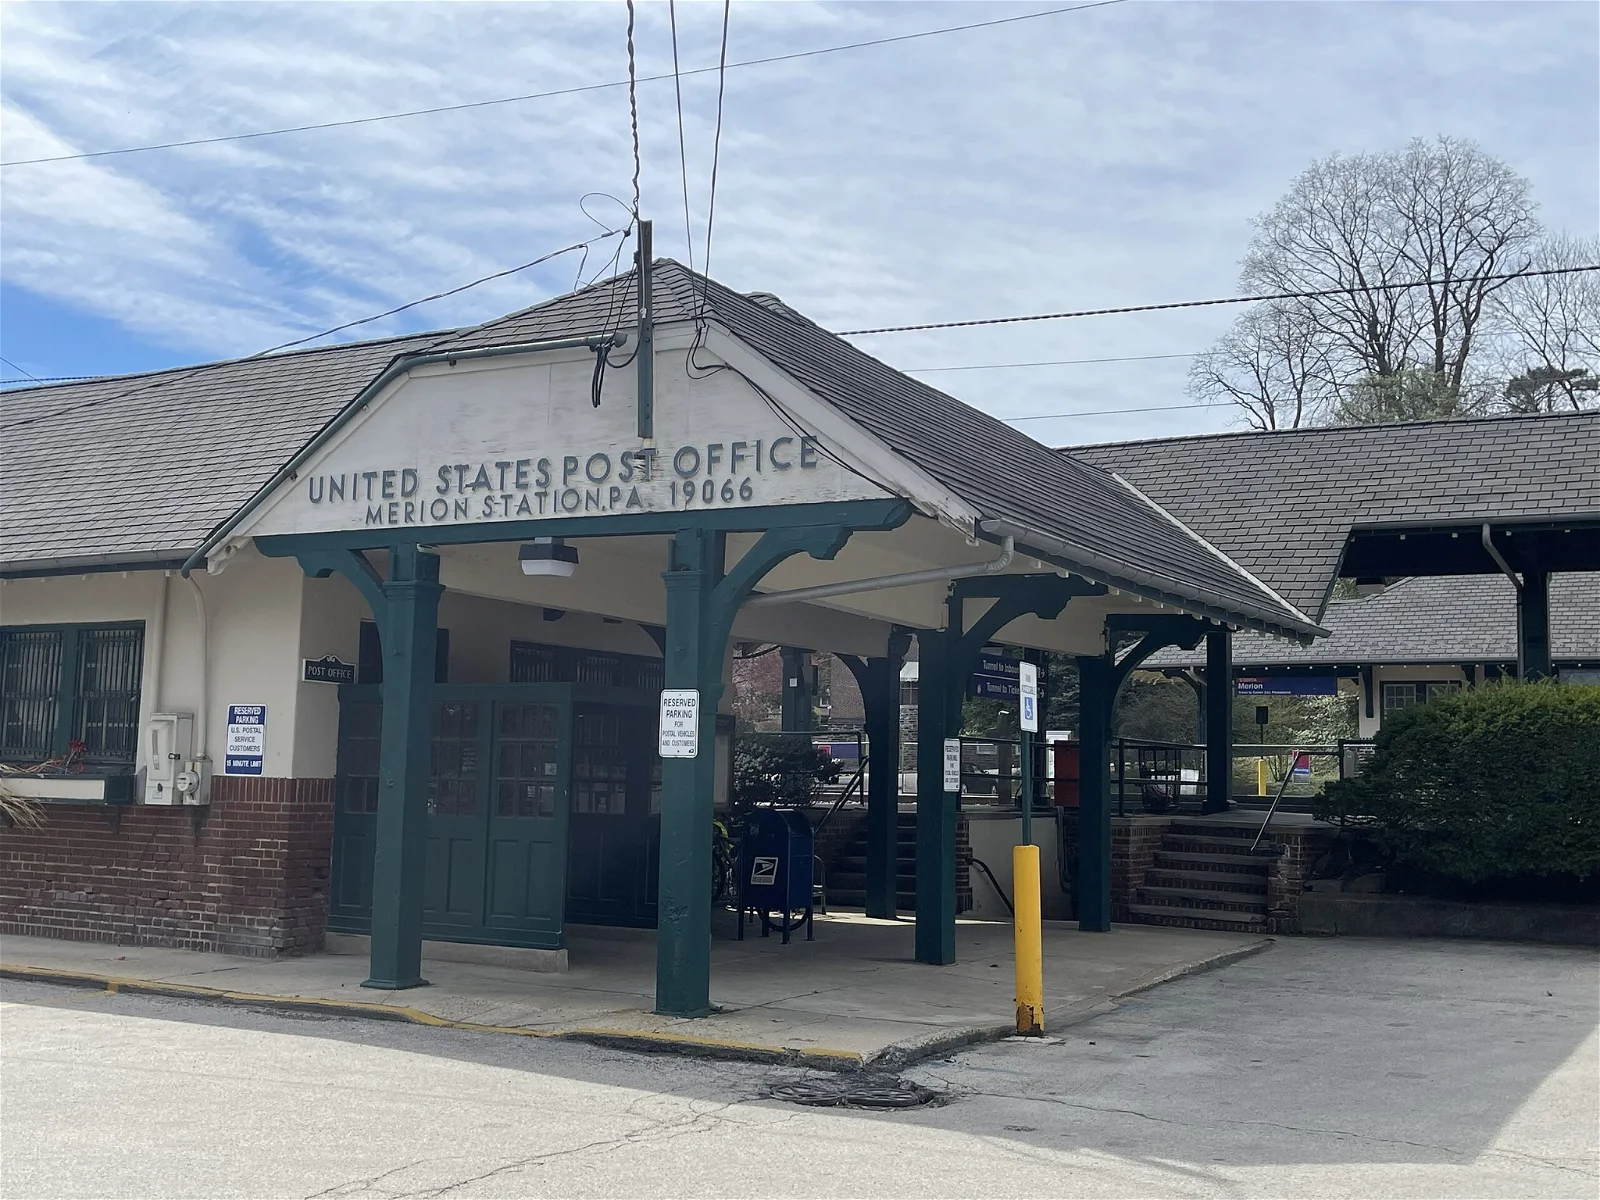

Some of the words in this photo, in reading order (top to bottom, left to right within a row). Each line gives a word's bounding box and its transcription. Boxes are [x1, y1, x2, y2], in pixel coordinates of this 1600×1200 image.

[309, 468, 419, 503] UNITED
[436, 458, 550, 495] STATES
[563, 448, 656, 486] POST
[674, 435, 818, 478] OFFICE
[366, 498, 468, 525] MERION
[670, 477, 753, 506] 19066
[308, 666, 325, 676] POST
[328, 668, 351, 679] OFFICE
[234, 707, 261, 715] RESERVED
[666, 710, 692, 718] PARKING
[235, 716, 259, 724] PARKING
